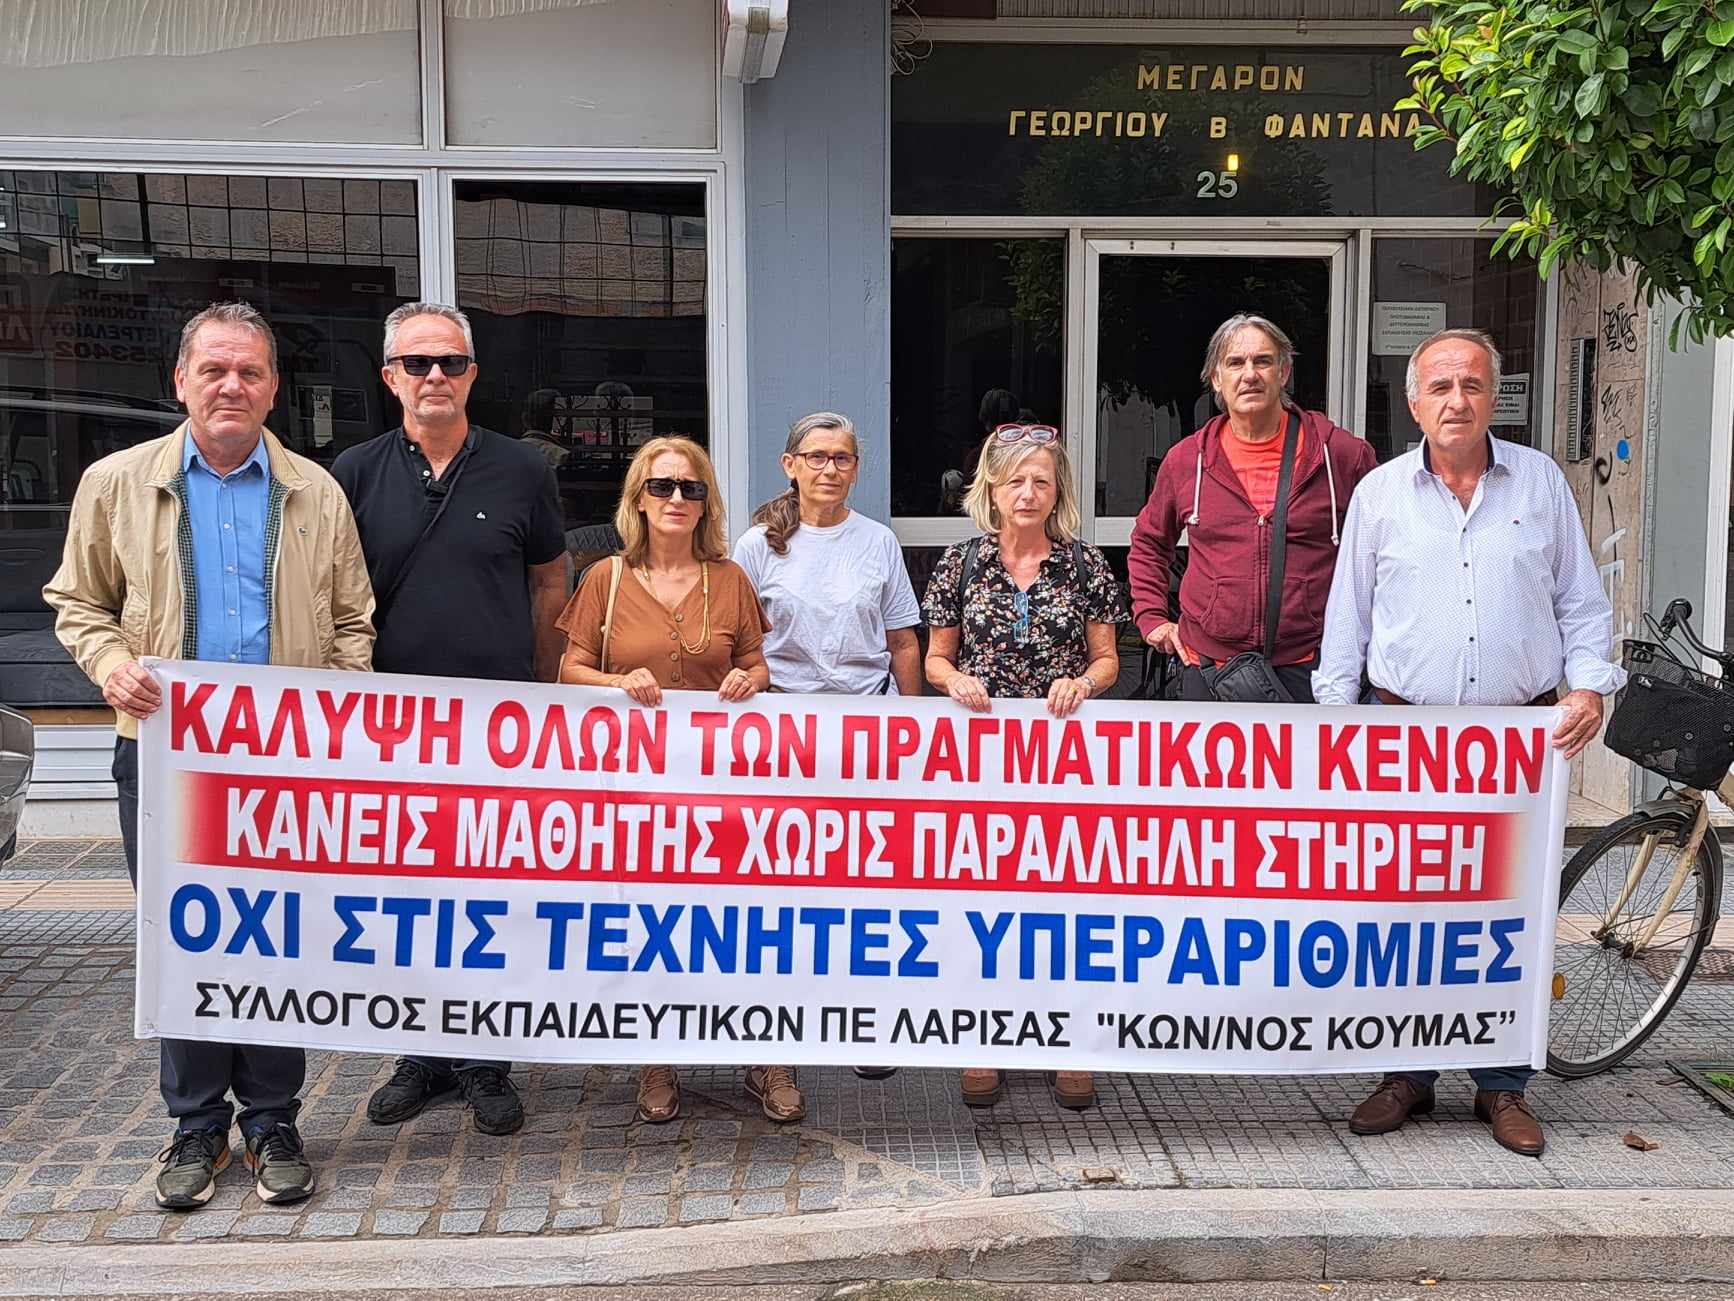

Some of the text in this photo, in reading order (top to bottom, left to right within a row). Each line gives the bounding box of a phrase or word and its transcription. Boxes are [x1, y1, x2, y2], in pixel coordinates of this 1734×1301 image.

[1137, 65, 1304, 91] ΜΕΓΑΡΟΝ
[1009, 110, 1422, 139] ΓΕΩΡΓΙΟΥ Β ΦΑΝΤΑΝΑ
[1197, 171, 1240, 198] 25
[170, 681, 1547, 796] ΚΑΛΥΨΗ ΟΛΩΝ ΤΩΝ ΠΡΑΓΜΑΤΙΚΩΝ ΚΕΝΩΝ
[225, 787, 1486, 892] ΚΑΝΕΙΣ ΜΑΘΗΤΗΣ ΧΩΡΙΣ ΠΑΡΑΛΛΗΛΗ ΣΤΗΡΙΞΗ
[168, 883, 1526, 990] ΟΧΙ ΣΤΙΣ ΤΕΧΝΗΤΕΣ ΥΠΕΡΑΡΙΘΜΙΕΣ
[195, 982, 426, 1032] ΣΥΛΛΟΓΟΣ
[441, 999, 804, 1042] ΕΚΠΑΙΔΕΥΤΙΚΩΝ
[820, 1006, 876, 1043] ΠΕ
[890, 1008, 1071, 1047] ΛΑΡΙΣΑΣ
[1097, 1012, 1313, 1051] "ΚΩΝ/ΝΟΣ
